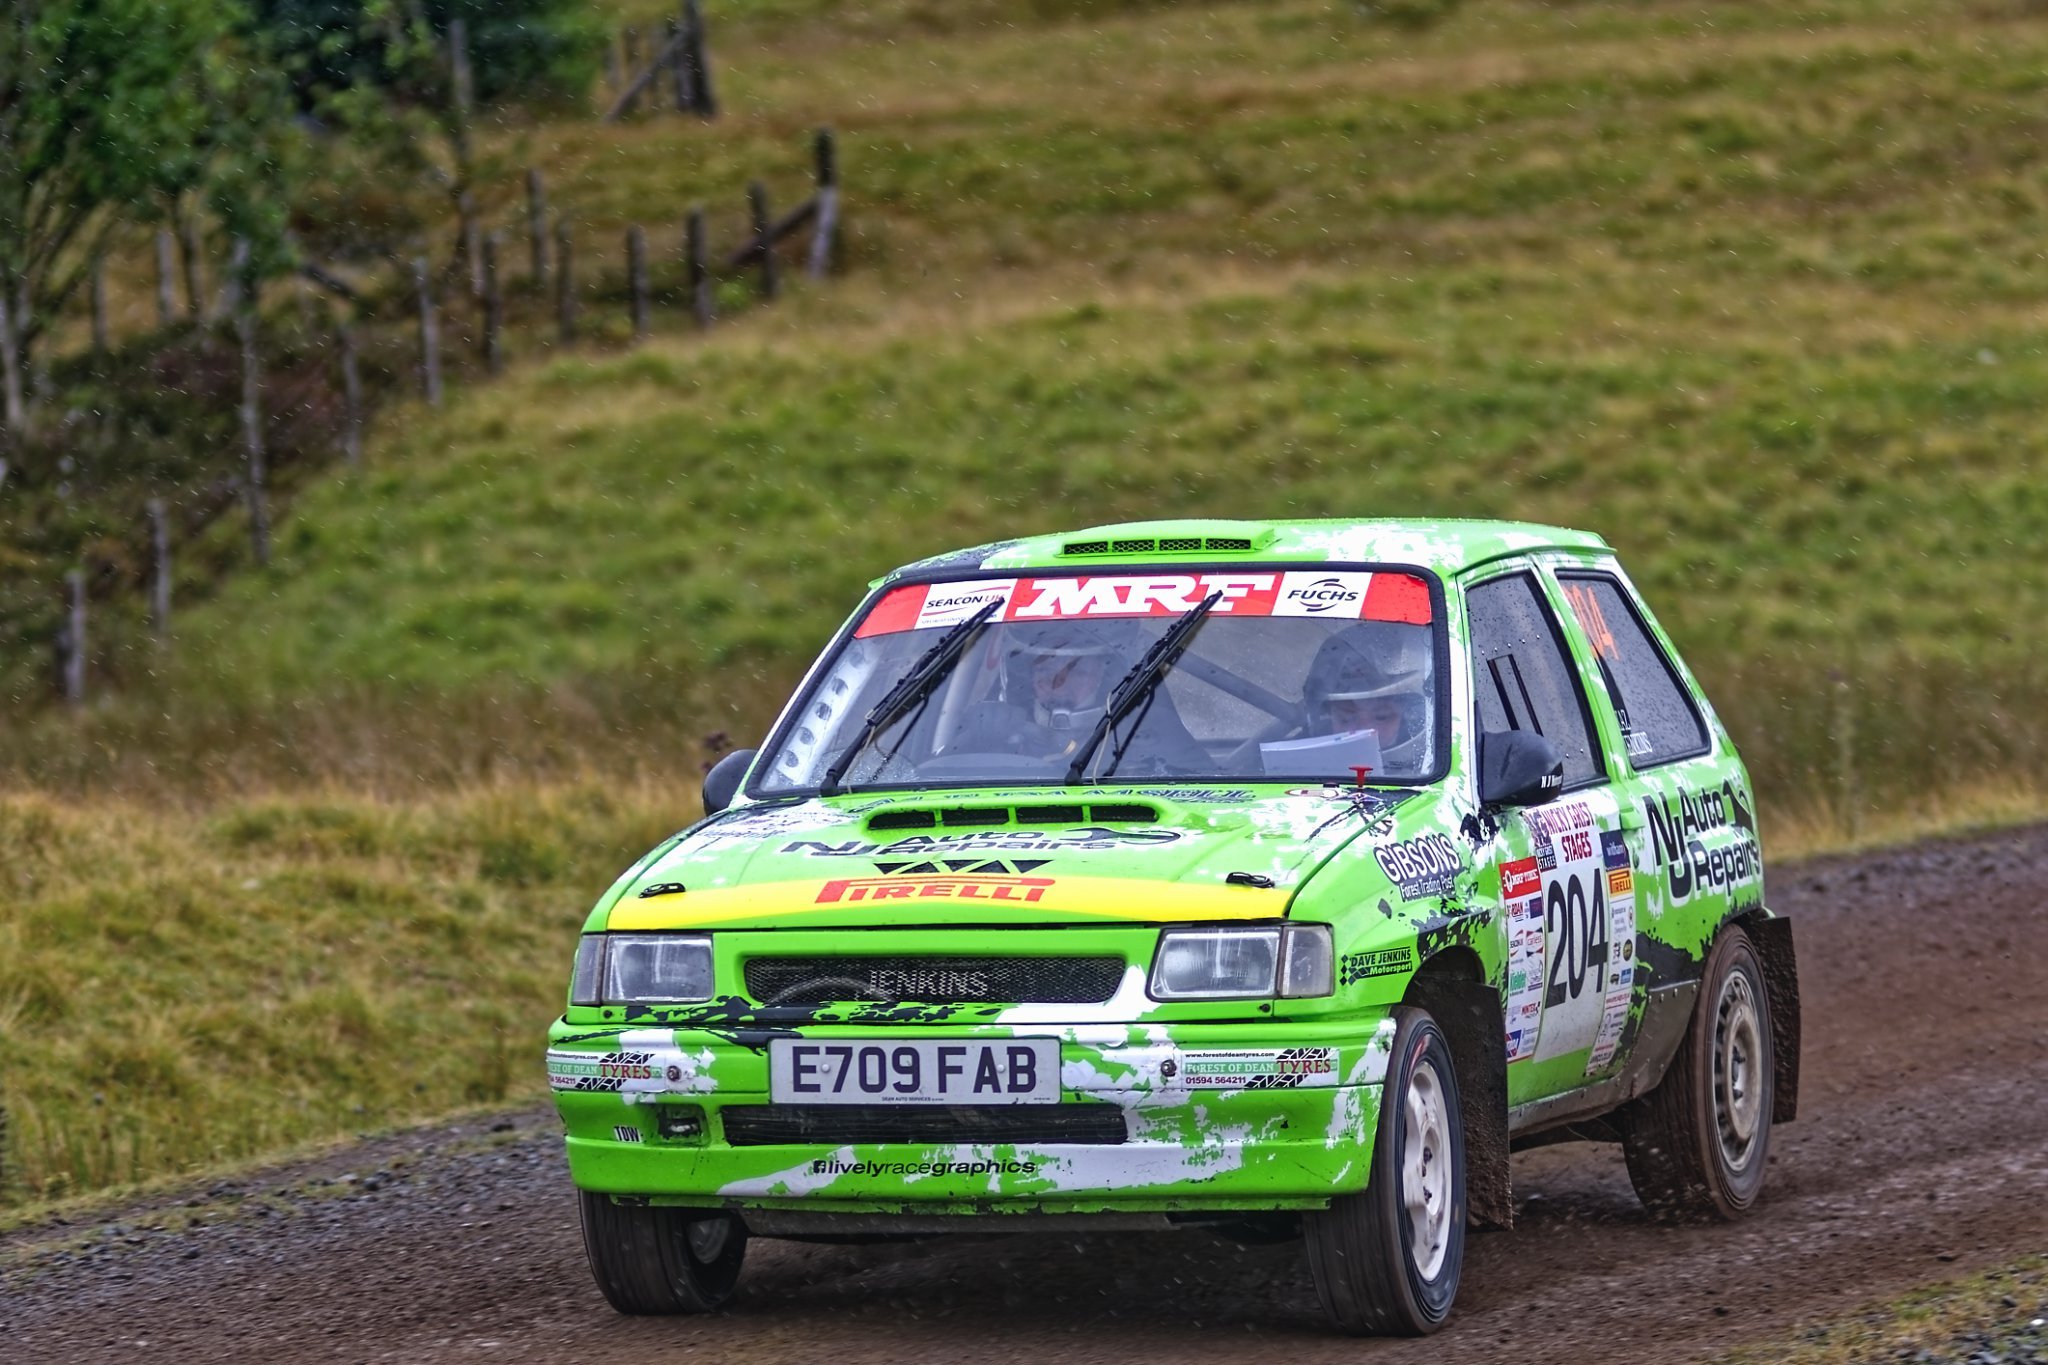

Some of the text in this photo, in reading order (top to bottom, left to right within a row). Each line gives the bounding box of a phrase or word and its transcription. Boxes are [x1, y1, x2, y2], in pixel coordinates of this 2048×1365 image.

[926, 595, 983, 608] SEACON
[1014, 575, 1276, 617] MRF
[1287, 589, 1359, 601] FUCHS
[1541, 806, 1571, 835] NICKY
[1566, 802, 1594, 829] GRIST
[780, 831, 1044, 857] NJ Auto
[876, 840, 1118, 856] Repairs
[1561, 831, 1593, 862] STAGES
[1642, 791, 1692, 899] NJ
[1678, 786, 1727, 836] Auto
[1375, 834, 1461, 882] GIBSONS
[1538, 856, 1557, 870] STAGES
[1688, 839, 1761, 896] Repairs
[814, 875, 1056, 904] PIRELLI
[1400, 875, 1455, 898] Forest Trading Post
[1609, 872, 1632, 894] PIRELLI
[1543, 868, 1608, 1009] 204
[1351, 949, 1412, 967] DAVE JENKINS
[1369, 962, 1412, 976] Motorsport
[863, 969, 988, 996] JENKINS
[561, 1064, 572, 1073] OF
[574, 1065, 598, 1075] DEAN
[599, 1064, 651, 1079] TYRES
[792, 1046, 1037, 1093] E709 FAB
[1187, 1058, 1331, 1074] FOREST OF DEAN TYRES
[1185, 1076, 1247, 1084] 01594 564211
[614, 1126, 640, 1142] TOW
[828, 1159, 1036, 1177] livelyracegraphics
